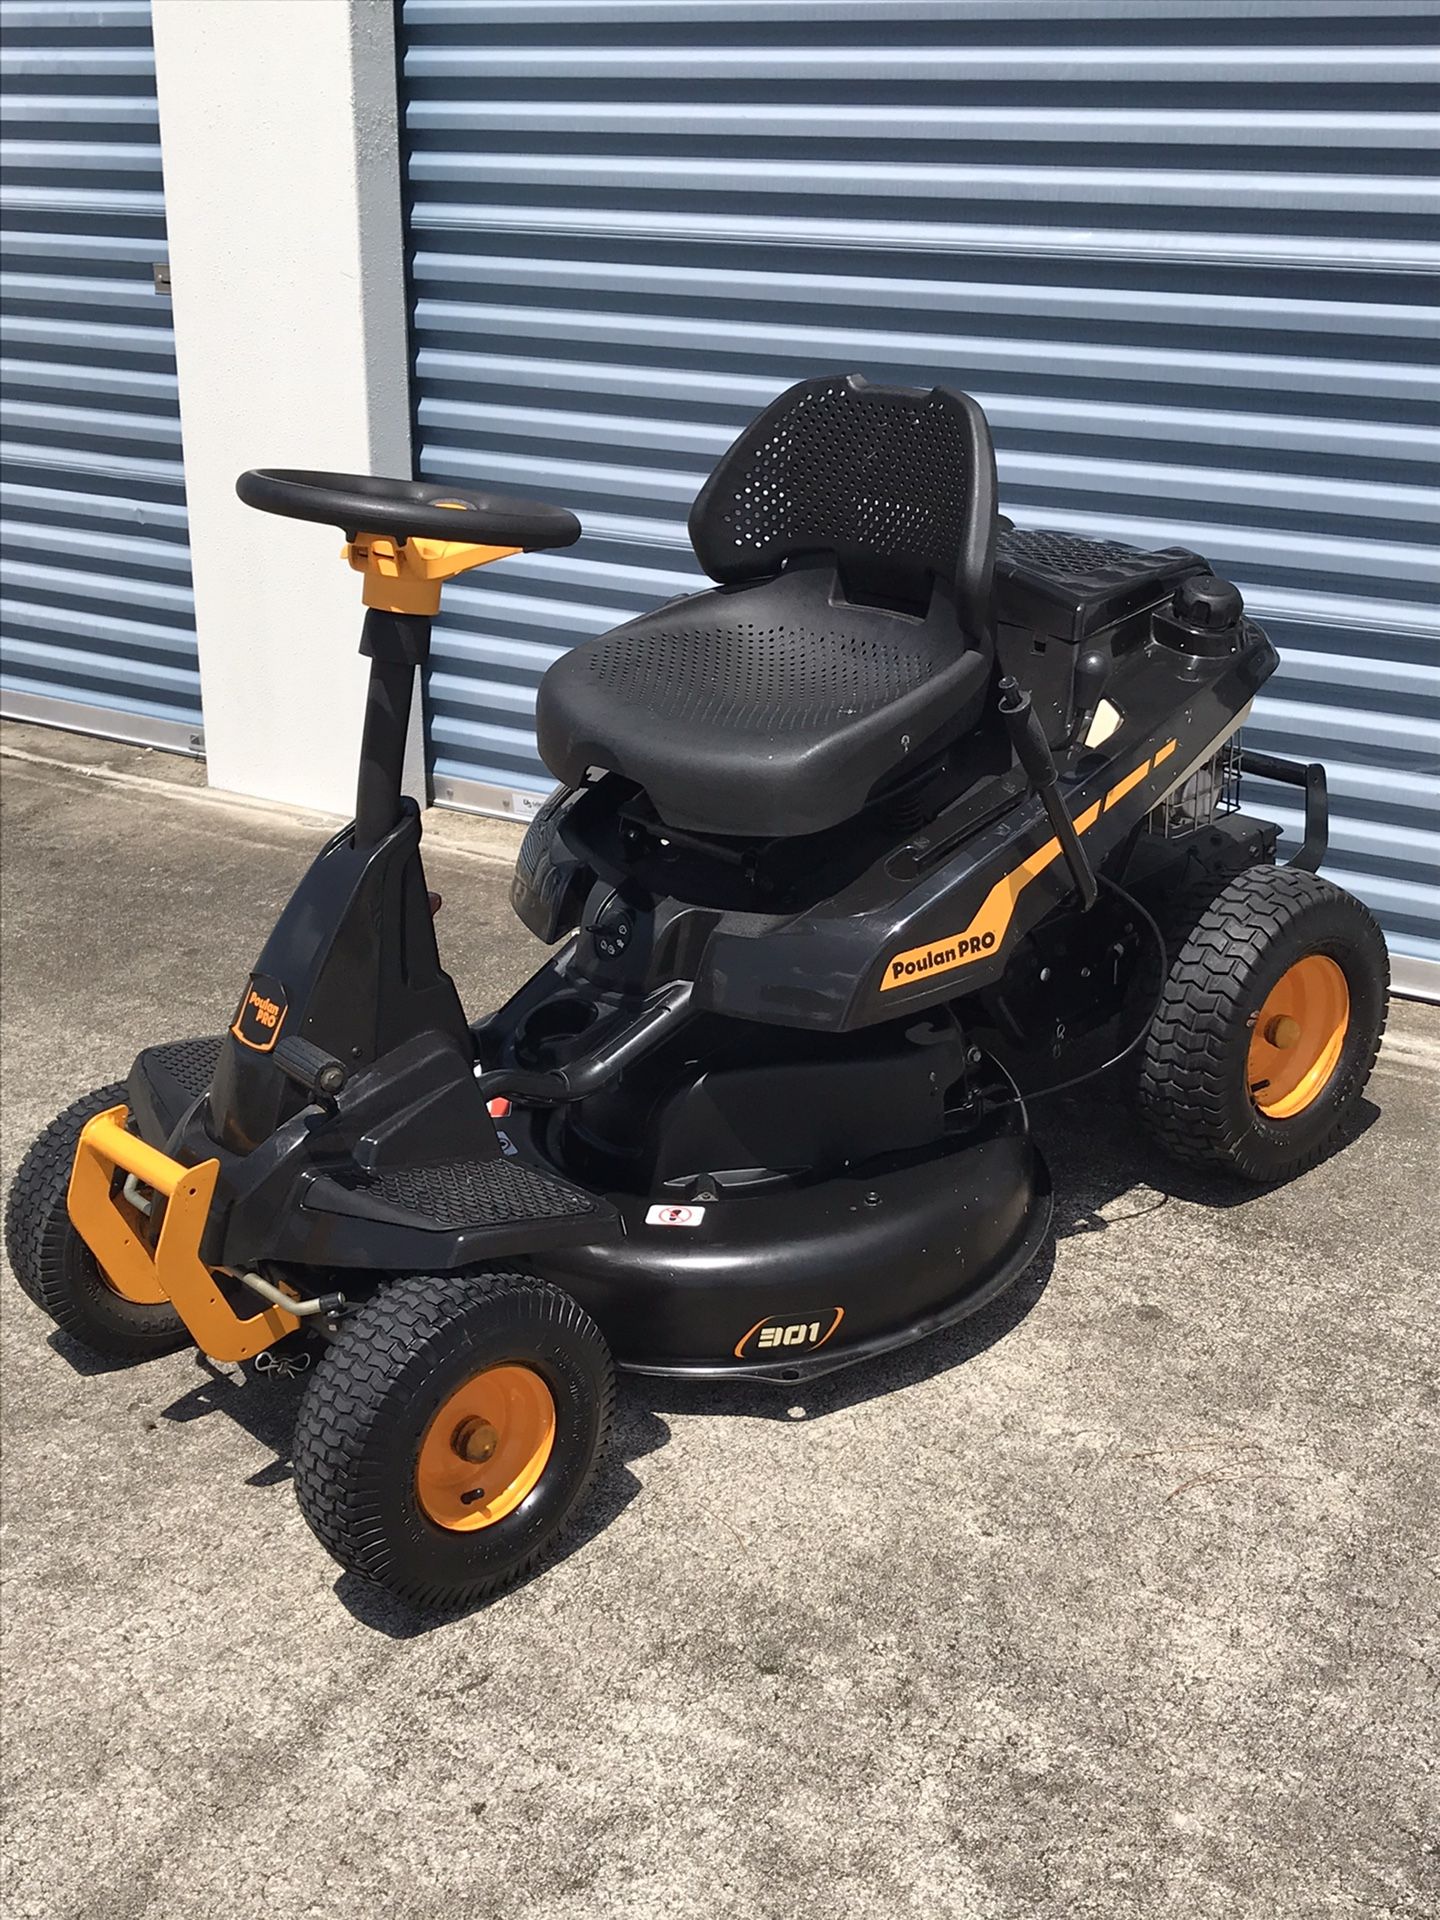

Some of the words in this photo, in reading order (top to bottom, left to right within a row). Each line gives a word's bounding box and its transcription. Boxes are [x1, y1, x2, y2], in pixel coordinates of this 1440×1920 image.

[892, 948, 957, 980] Poulan
[957, 931, 996, 958] PRO
[248, 991, 280, 1016] Poulan
[255, 1008, 276, 1028] PRO
[757, 1321, 821, 1348] 301
